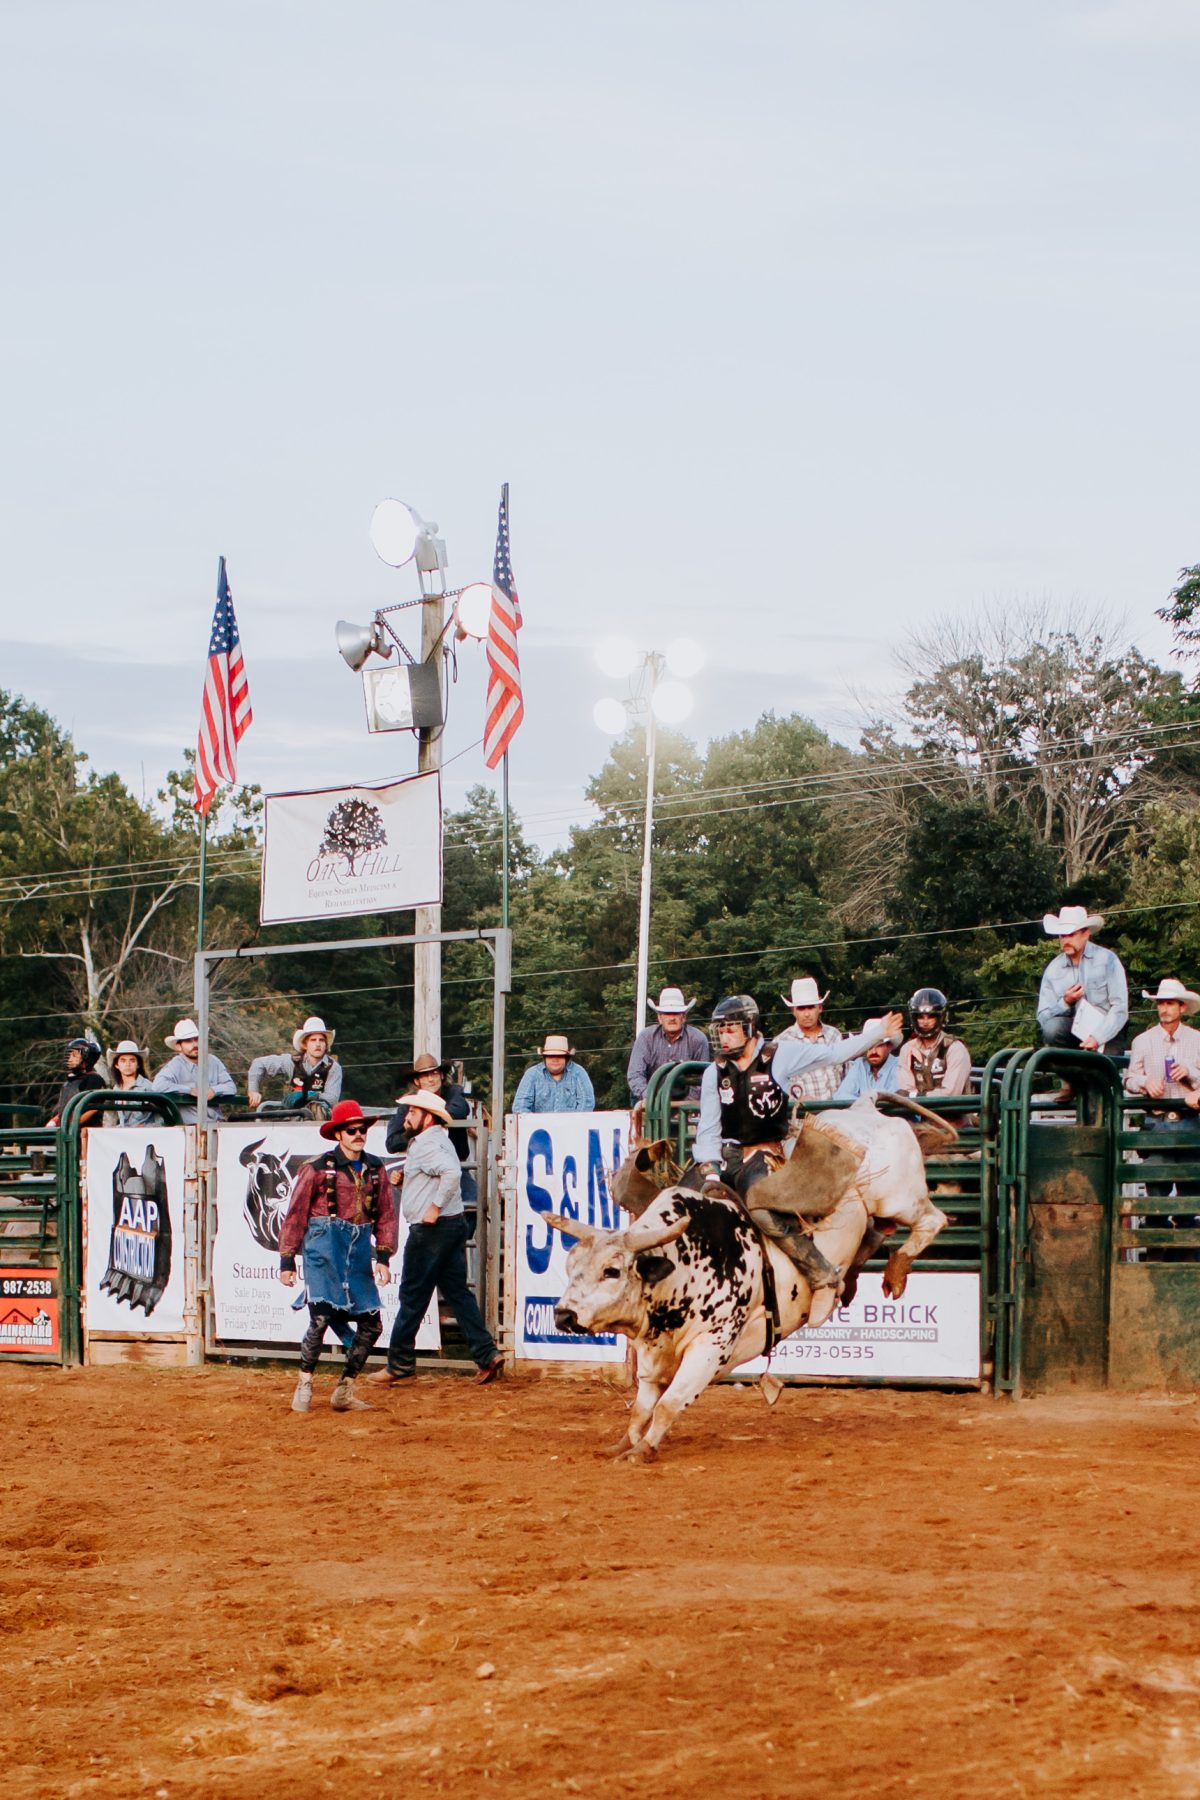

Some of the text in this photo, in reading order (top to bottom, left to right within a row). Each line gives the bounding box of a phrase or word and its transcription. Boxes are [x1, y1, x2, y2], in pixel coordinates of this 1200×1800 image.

[360, 852, 401, 877] HILL
[526, 1128, 621, 1276] S&N
[119, 1197, 158, 1233] AAP
[114, 1229, 156, 1279] CONSTRUCTION
[3, 1280, 52, 1295] 987-2538
[234, 1287, 271, 1303] Sale Days
[221, 1303, 285, 1318] Tuesday 2:00 pm
[864, 1305, 938, 1323] BRICK
[0, 1324, 52, 1337] AINGUARD
[224, 1318, 282, 1333] Friday 2:00 pm
[804, 1328, 853, 1340] MASONRY
[860, 1329, 936, 1341] HARDSCAPING
